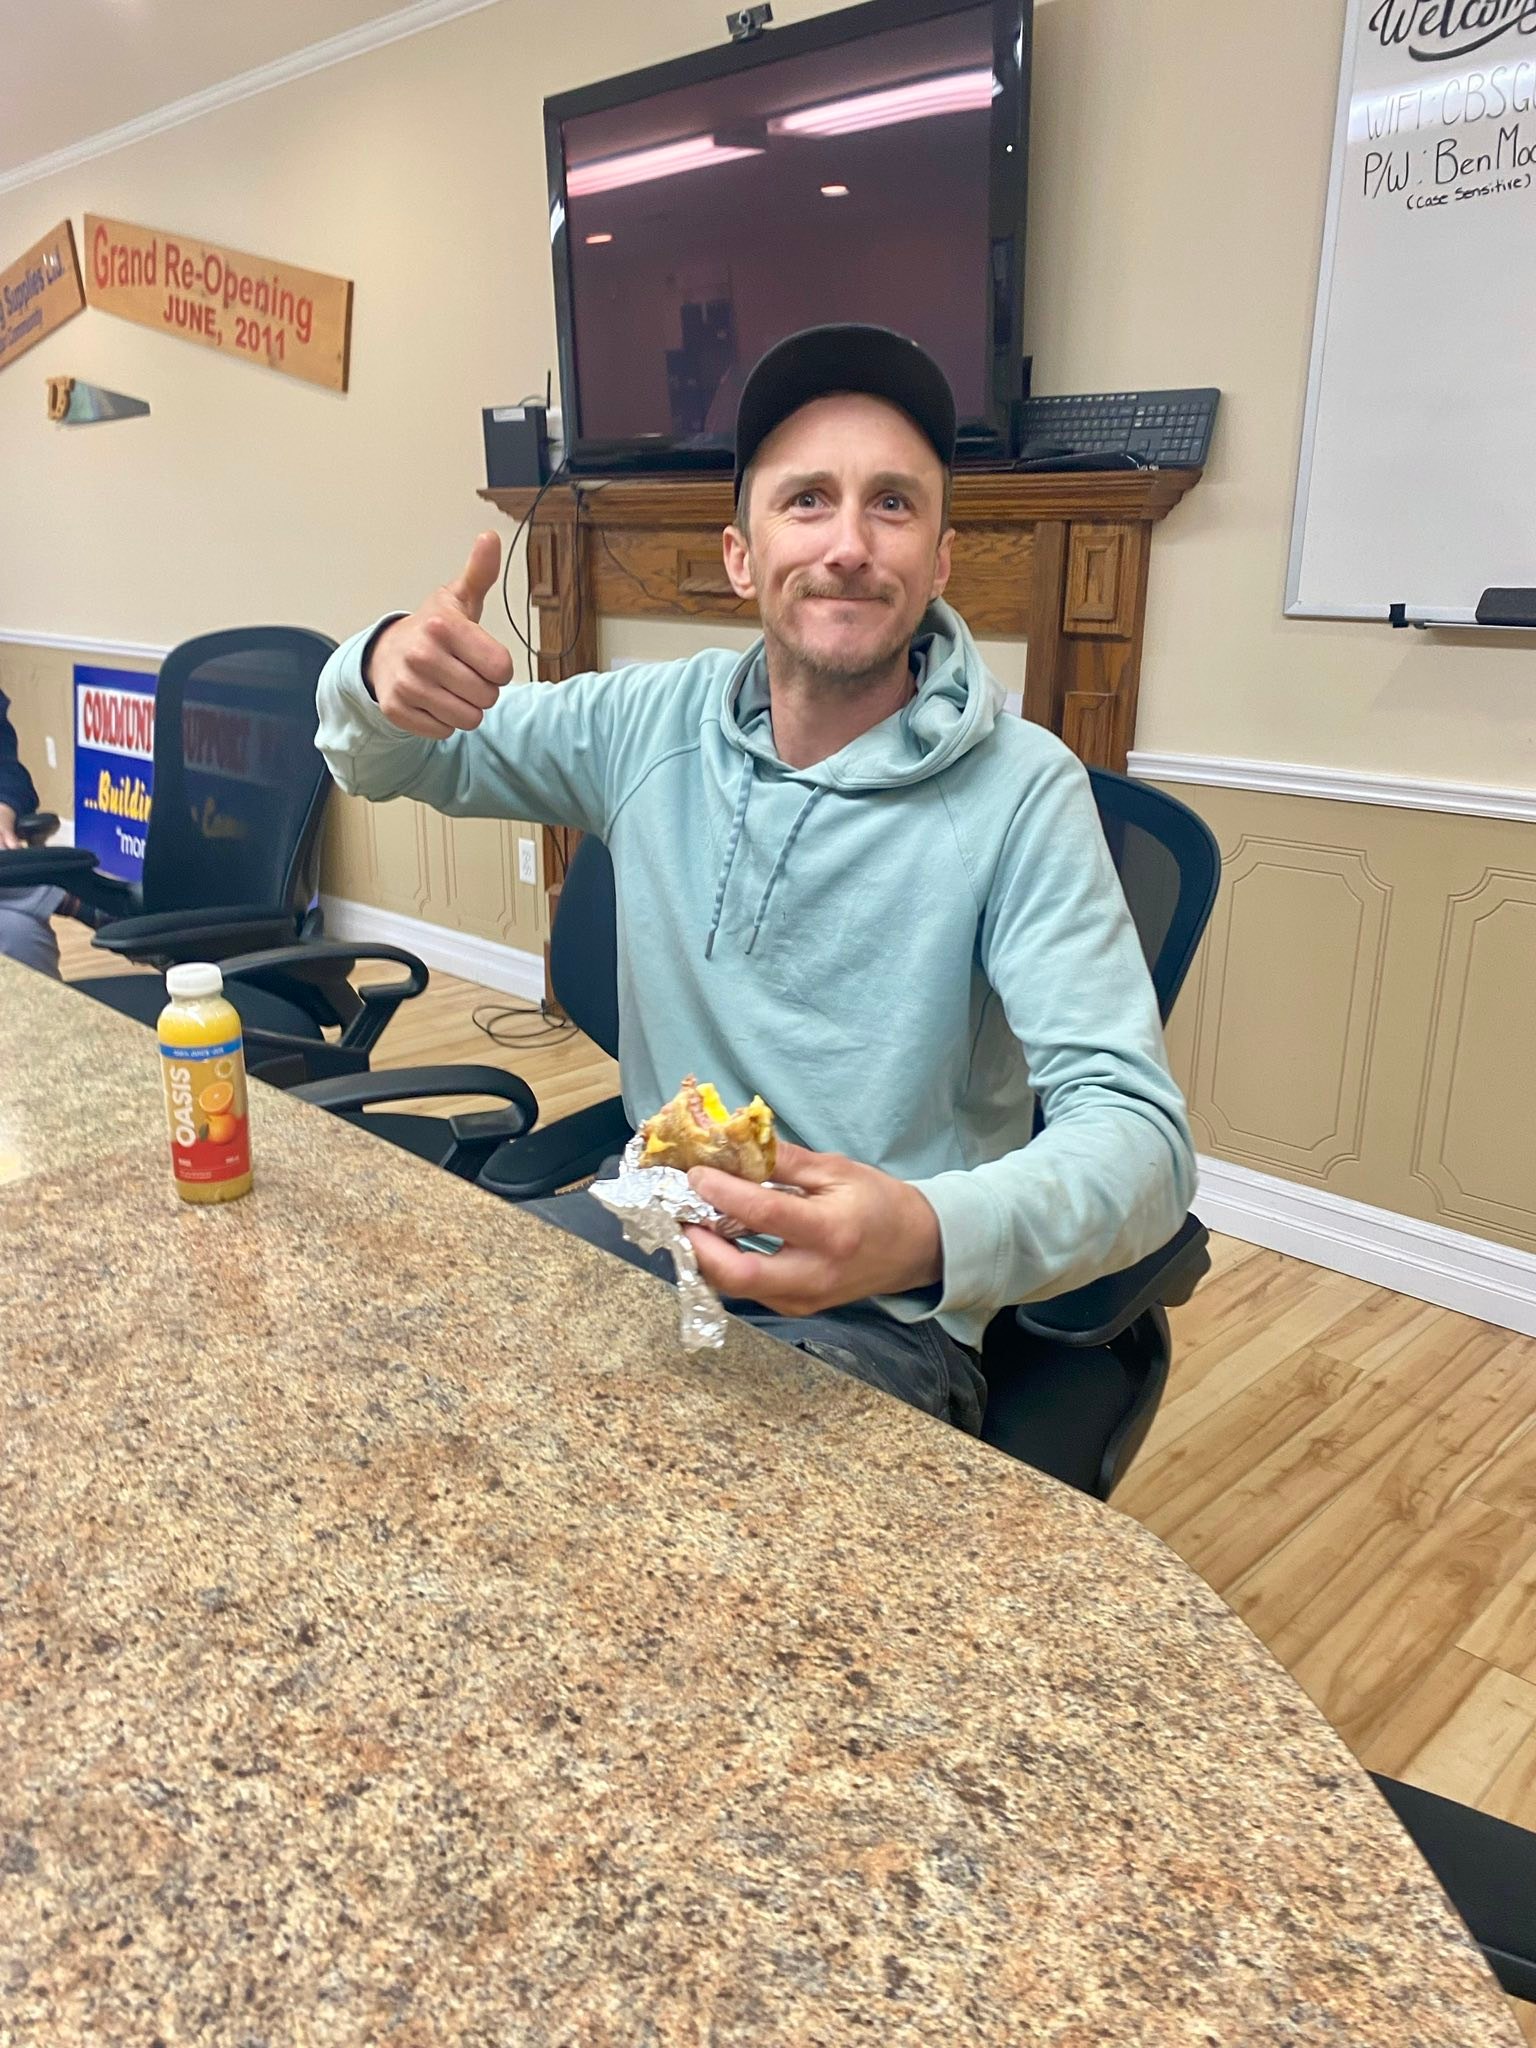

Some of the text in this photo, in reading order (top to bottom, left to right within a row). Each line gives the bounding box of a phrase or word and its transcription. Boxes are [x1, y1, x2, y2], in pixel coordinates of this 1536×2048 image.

[1368, 0, 1536, 46] Welcom
[1441, 61, 1536, 126] CBSG
[93, 224, 313, 344] Grand Re-Opening
[163, 294, 286, 361] JUNE, 2011
[83, 689, 156, 754] COMMUNI
[170, 1066, 197, 1147] OASIS
